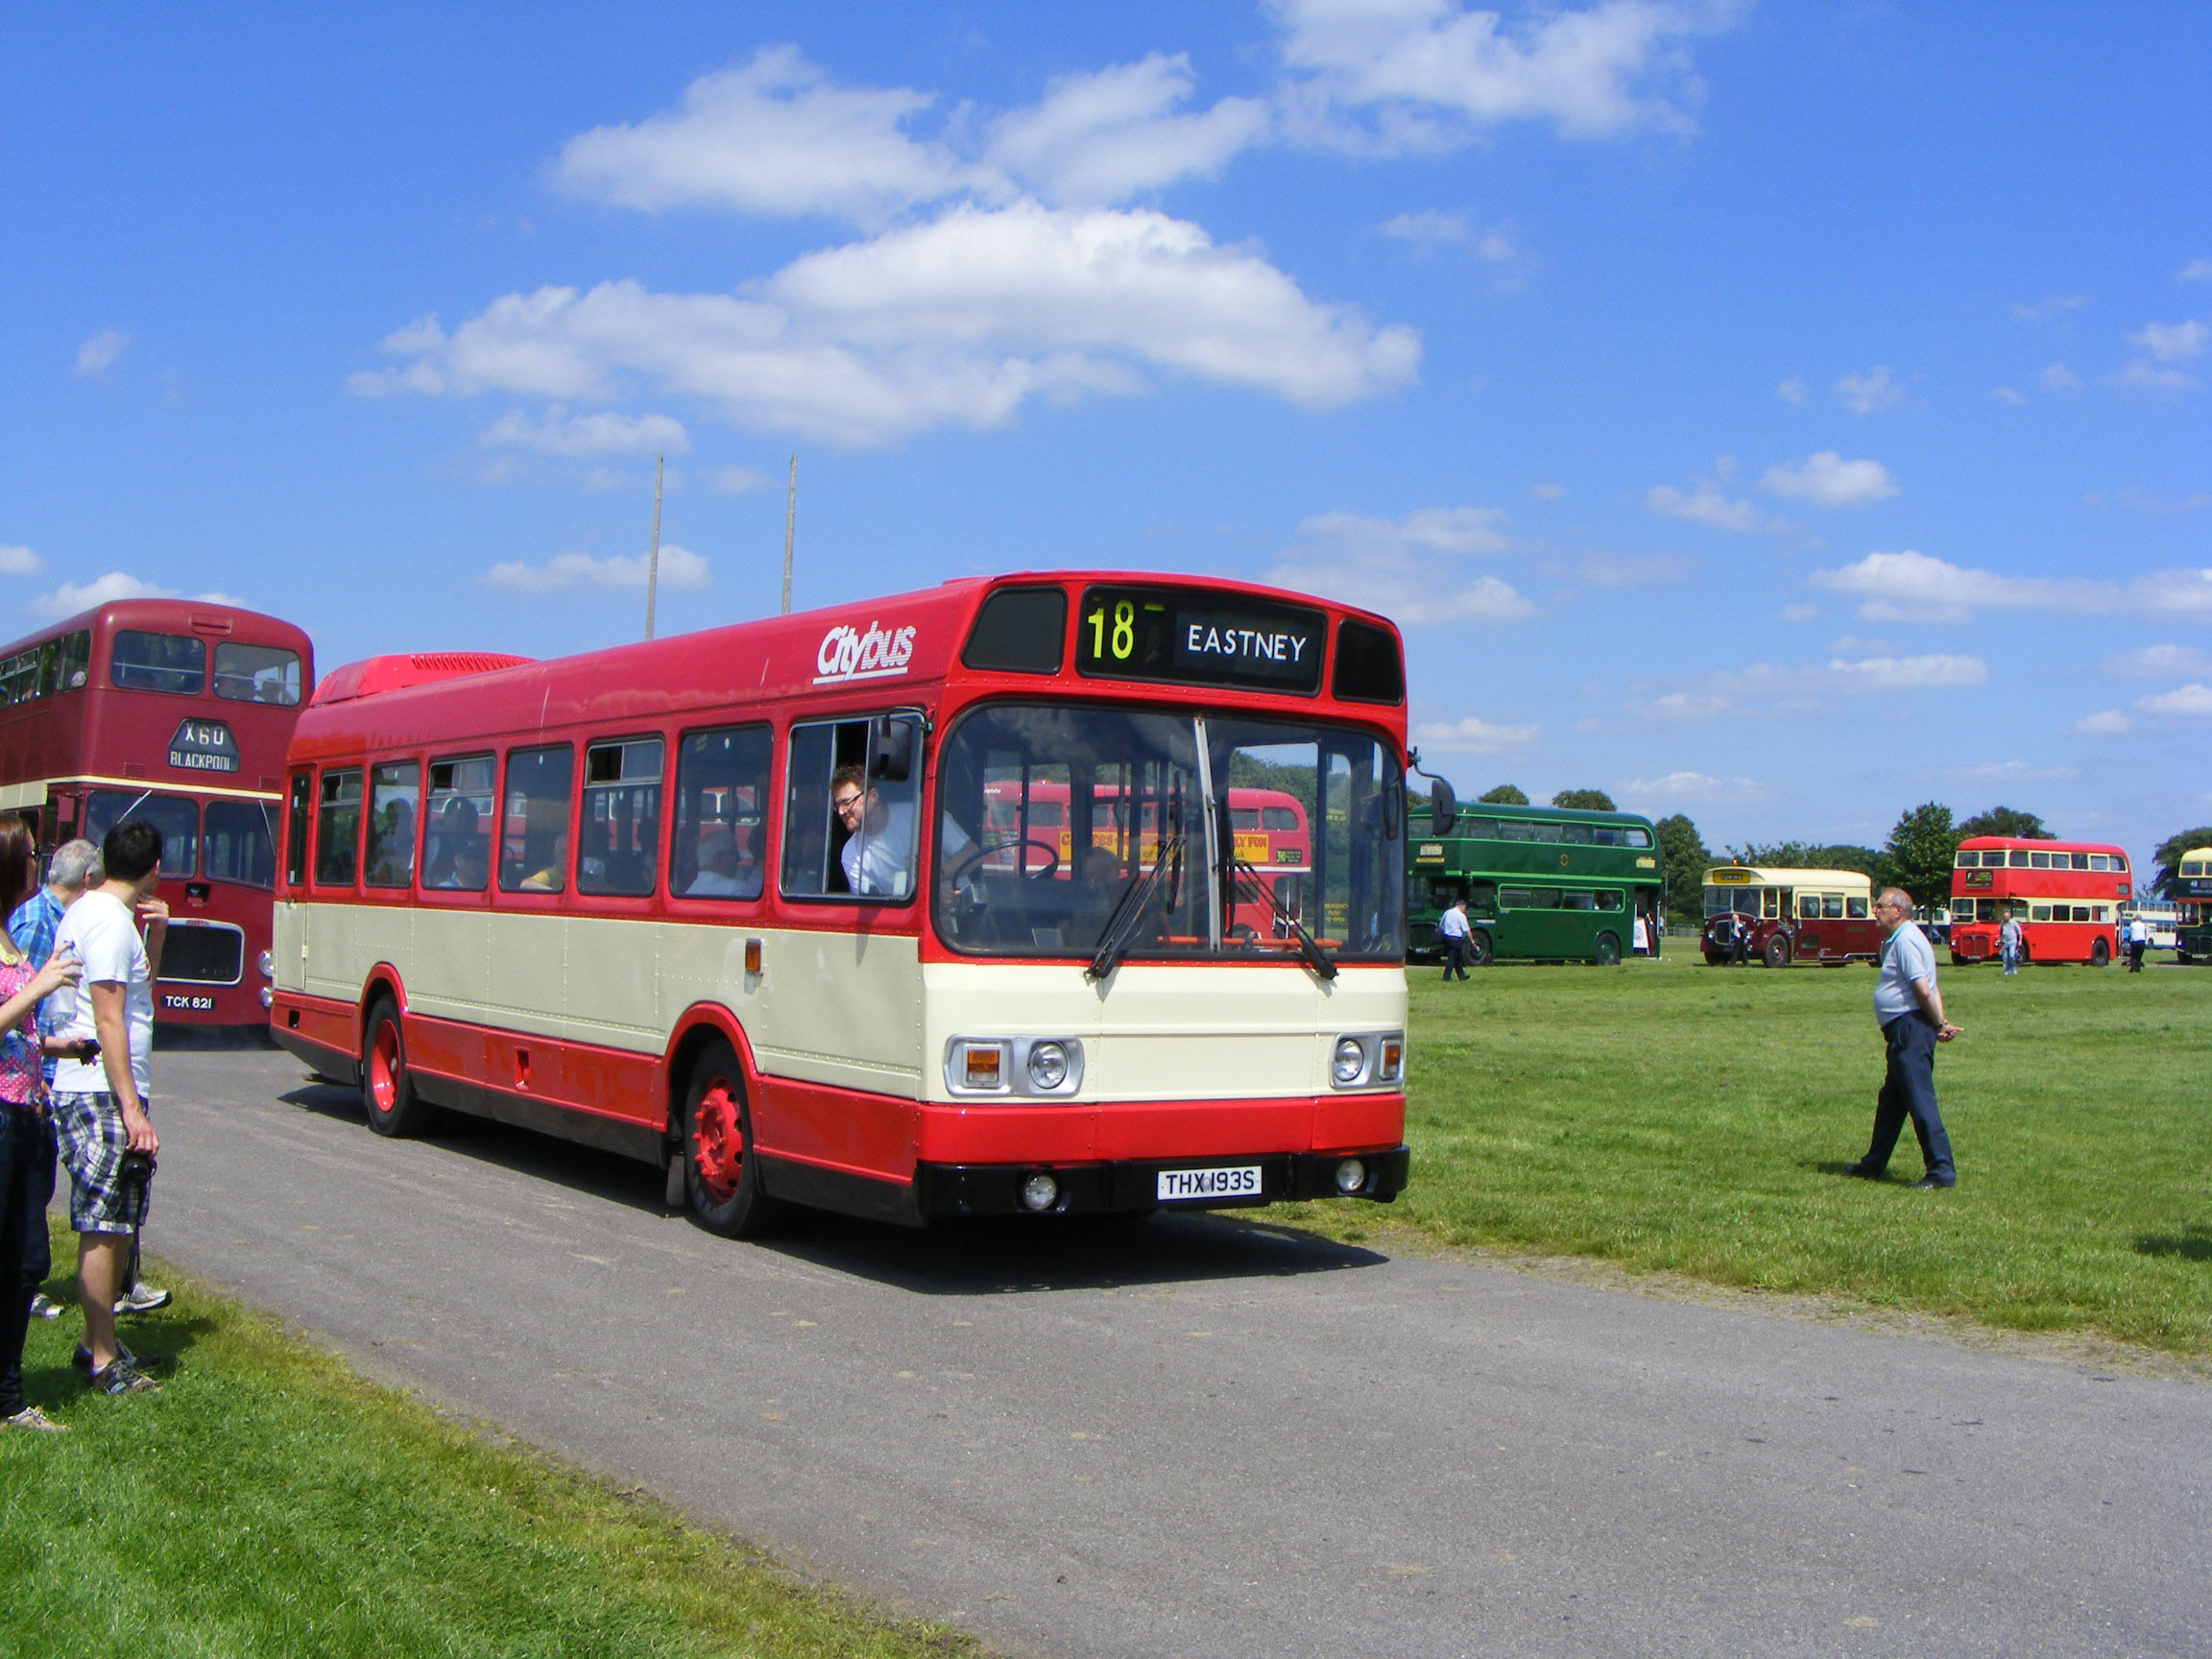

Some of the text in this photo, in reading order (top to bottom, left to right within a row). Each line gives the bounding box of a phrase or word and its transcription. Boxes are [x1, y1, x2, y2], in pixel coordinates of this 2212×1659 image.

[1088, 600, 1307, 661] 18 EASTNEY
[817, 620, 917, 681] Citybus
[185, 722, 224, 745] X60
[170, 751, 230, 770] BLACKPOOL
[165, 996, 212, 1010] TCK 821
